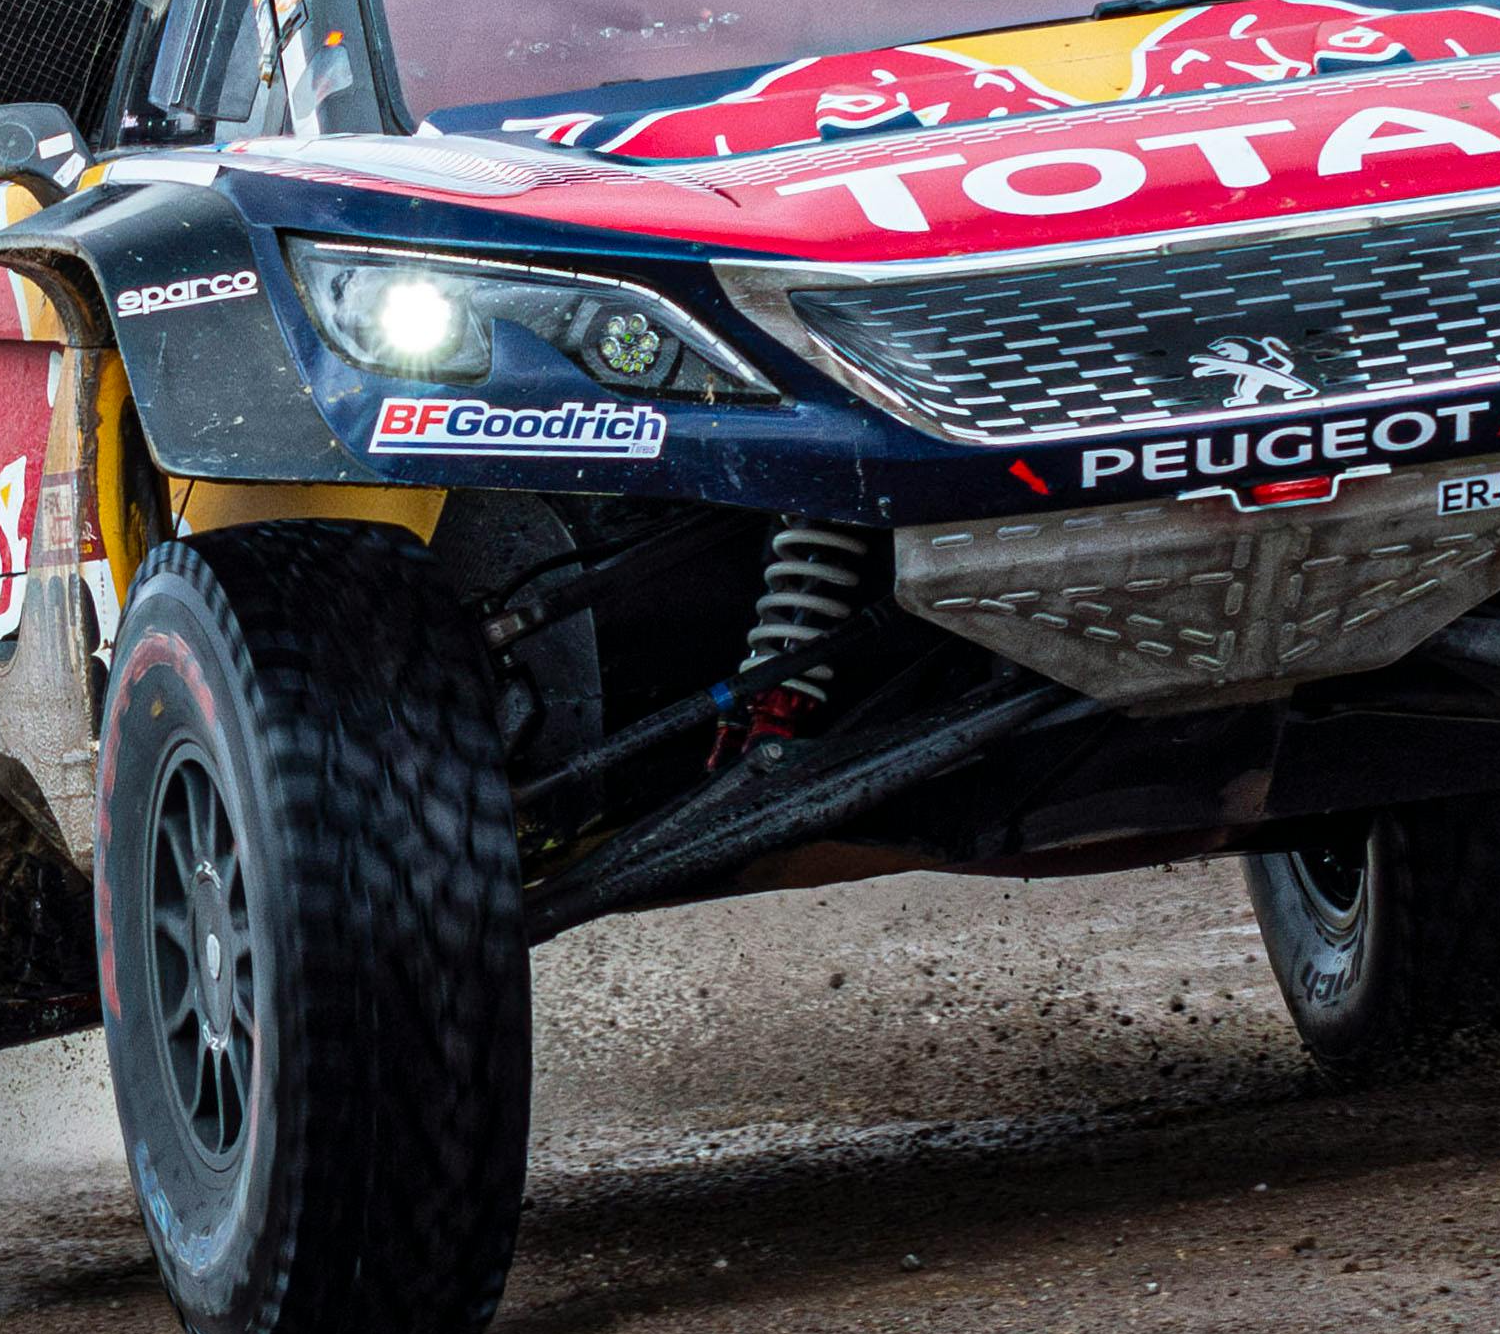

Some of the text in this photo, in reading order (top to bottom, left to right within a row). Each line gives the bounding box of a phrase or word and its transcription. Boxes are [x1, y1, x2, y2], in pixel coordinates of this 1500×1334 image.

[117, 270, 257, 315] sparco
[380, 404, 661, 441] BFGoodrich
[1082, 402, 1490, 488] PEUGEOT
